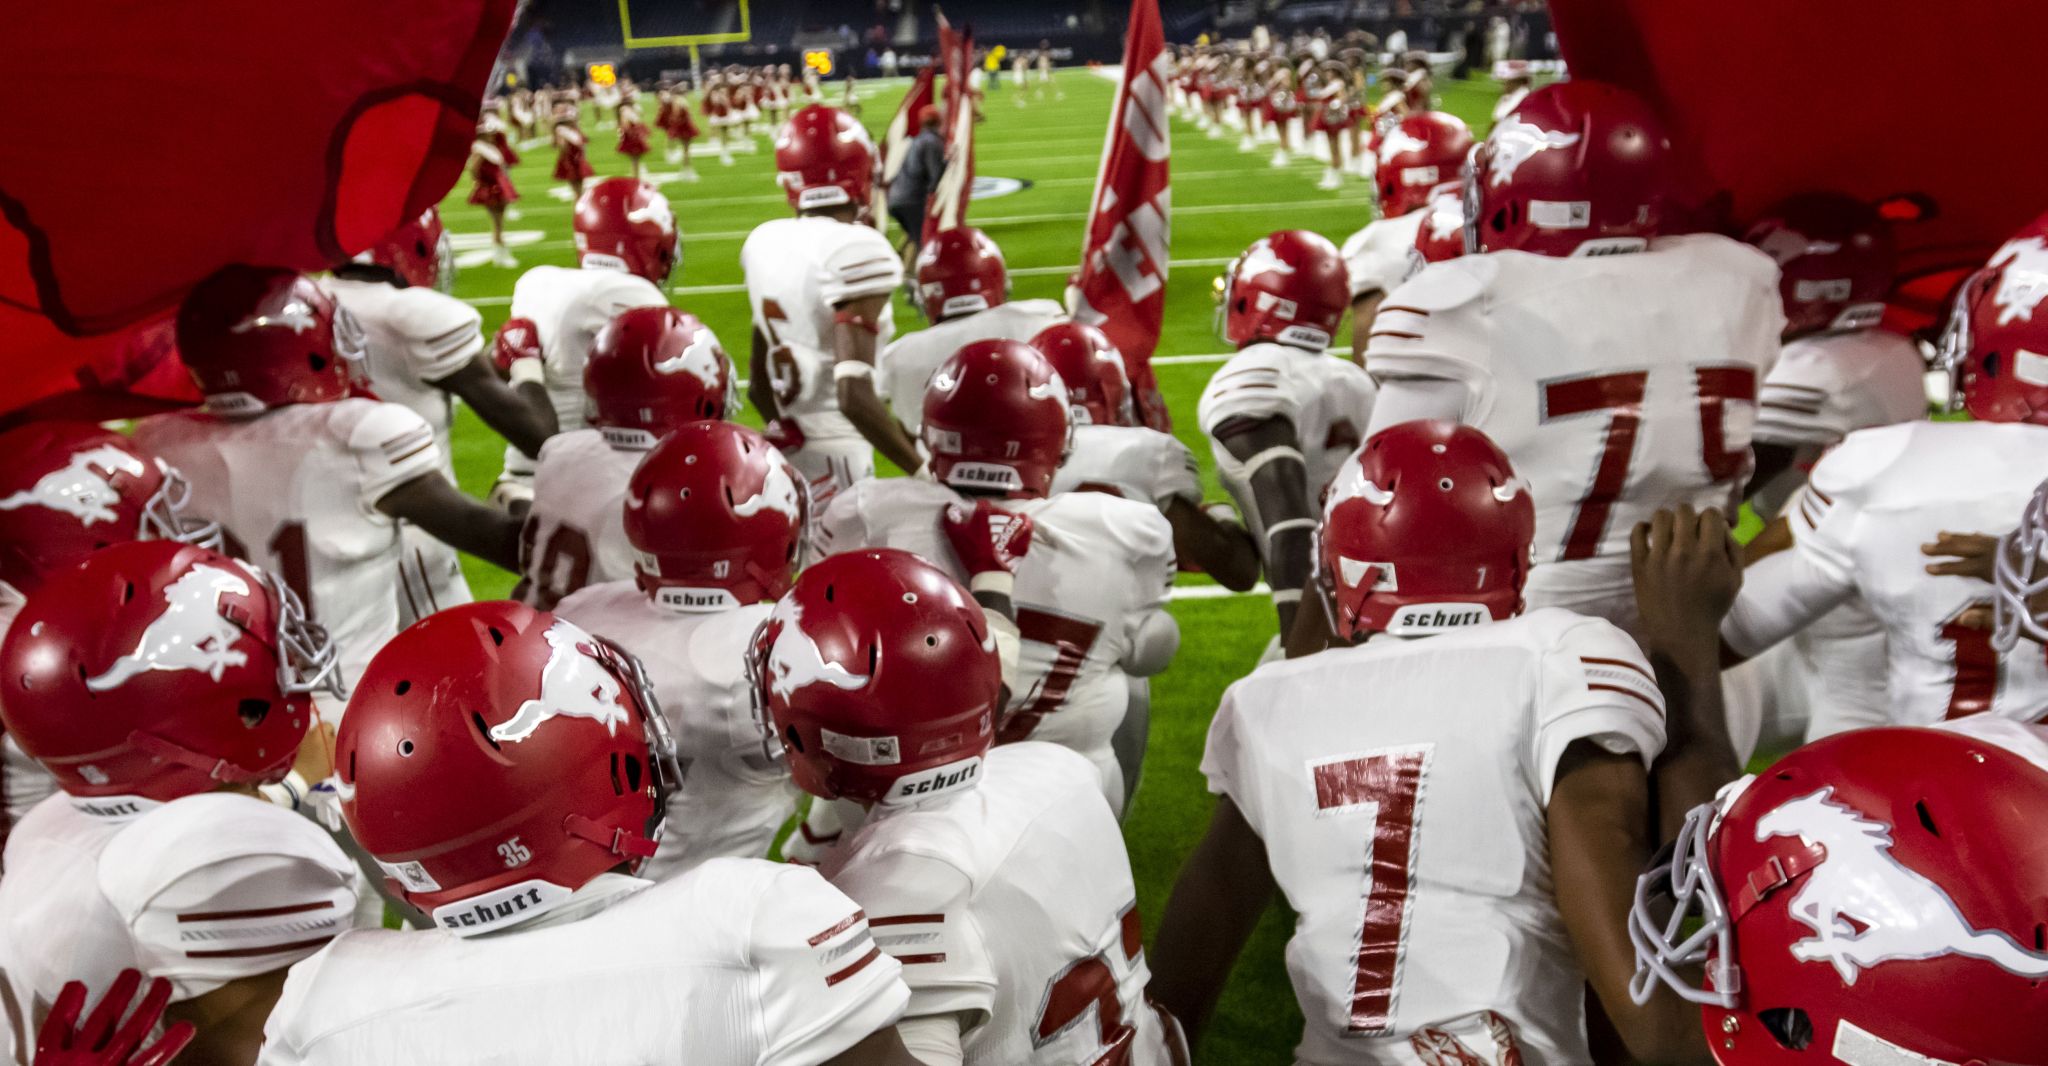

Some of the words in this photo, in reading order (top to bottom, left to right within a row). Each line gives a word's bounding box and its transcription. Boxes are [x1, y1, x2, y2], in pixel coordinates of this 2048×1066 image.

[957, 467, 1013, 483] schutt
[662, 592, 724, 607] schutt
[1402, 608, 1483, 628] schutt
[900, 763, 978, 797] schutt
[496, 835, 532, 868] 35
[1305, 742, 1436, 1038] 7
[442, 887, 543, 929] schutt
